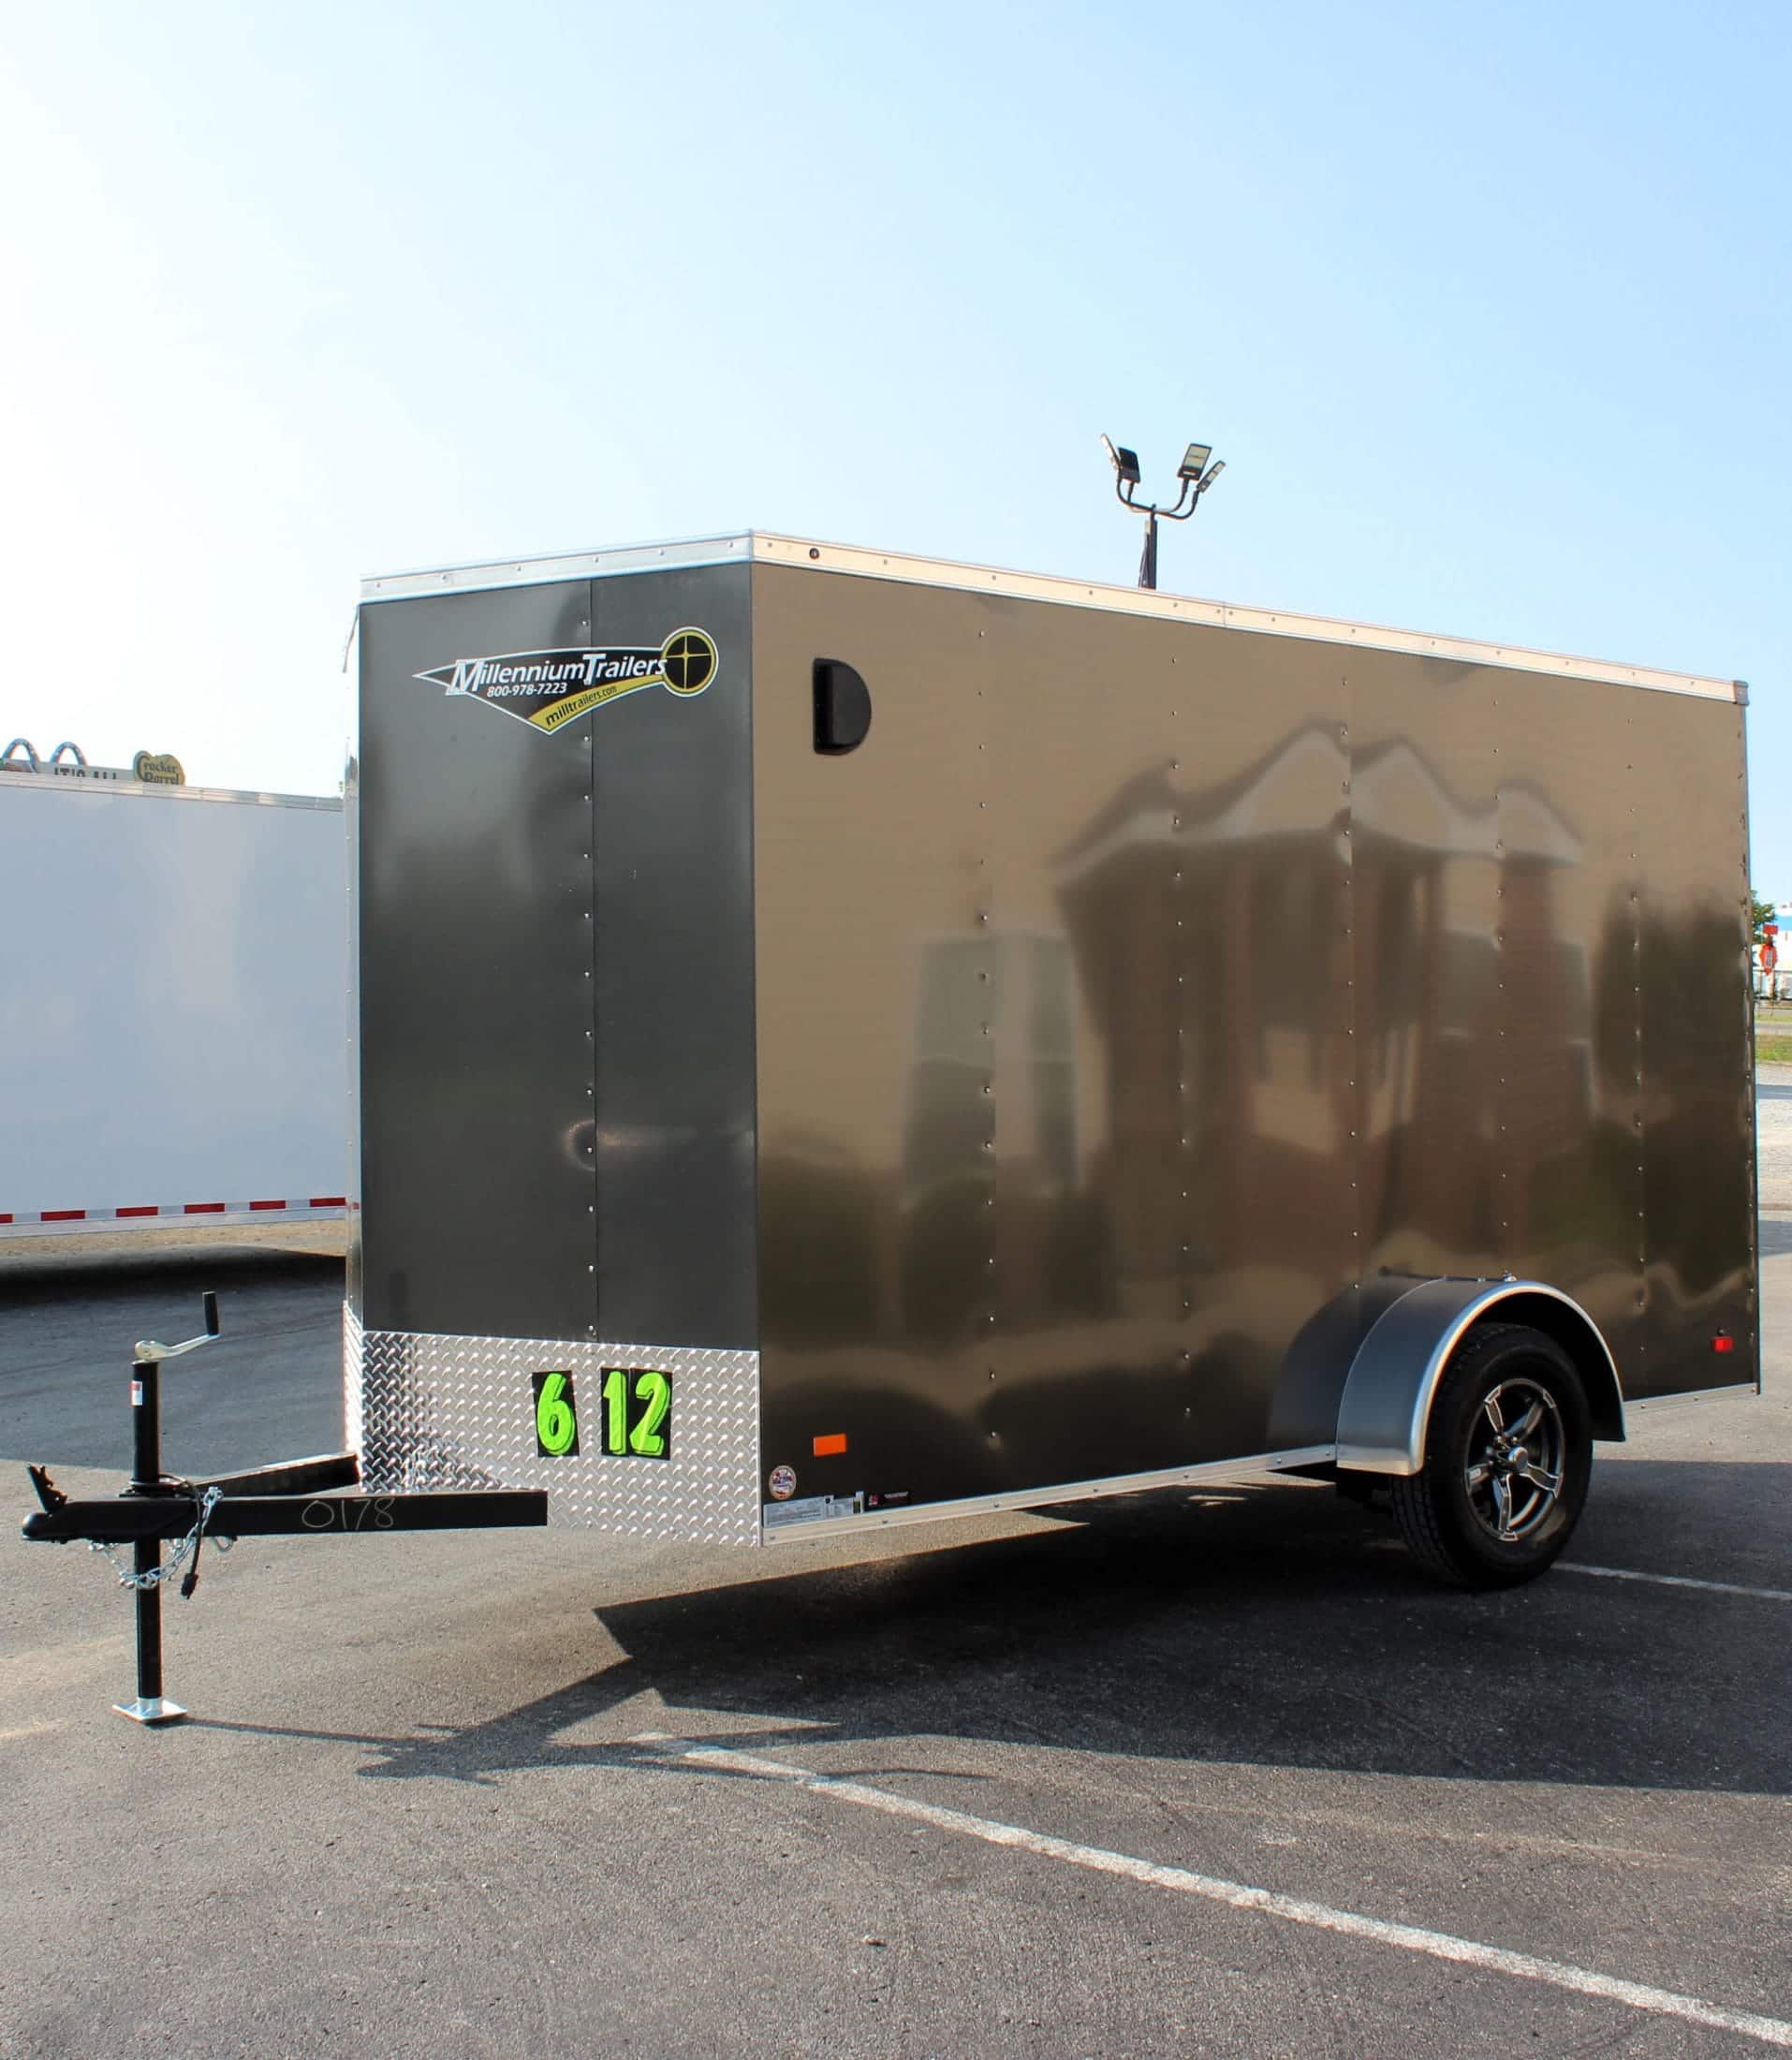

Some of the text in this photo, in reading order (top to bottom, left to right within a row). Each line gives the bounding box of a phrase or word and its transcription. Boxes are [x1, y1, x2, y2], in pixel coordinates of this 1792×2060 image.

[487, 682, 567, 698] 800-978-7223
[546, 685, 618, 726] milltrailers.com
[537, 1371, 670, 1456] 6 12
[301, 1497, 395, 1530] 0178
